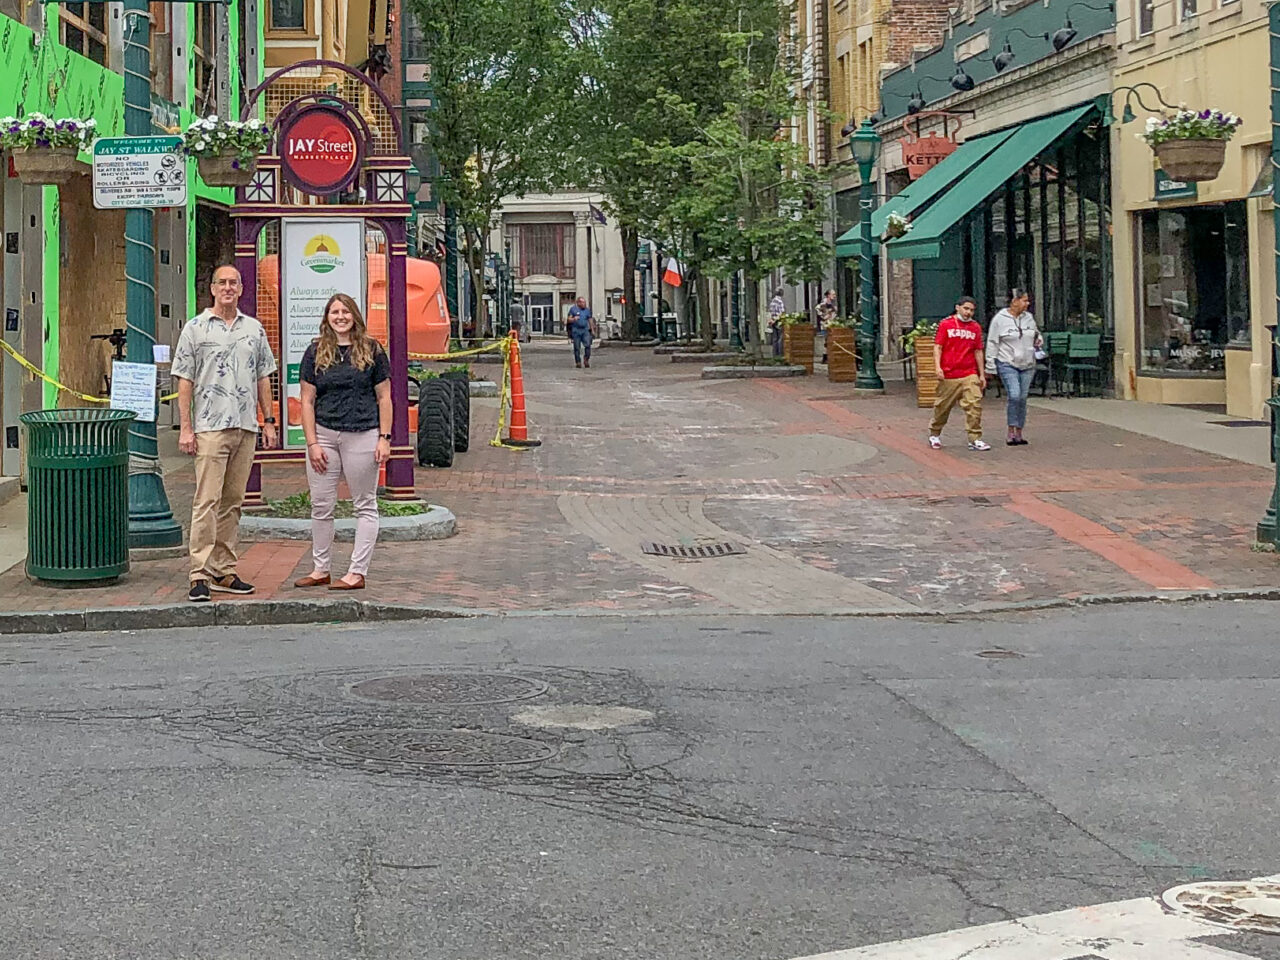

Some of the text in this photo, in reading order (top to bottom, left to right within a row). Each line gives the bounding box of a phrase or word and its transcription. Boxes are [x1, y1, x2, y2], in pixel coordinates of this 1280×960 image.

[117, 146, 131, 154] ST
[289, 139, 353, 155] JAY Street
[906, 155, 944, 165] KETT
[290, 287, 319, 296] Always
[290, 304, 319, 314] Always
[947, 328, 976, 339] Kappa
[1170, 348, 1202, 358] MUSIC
